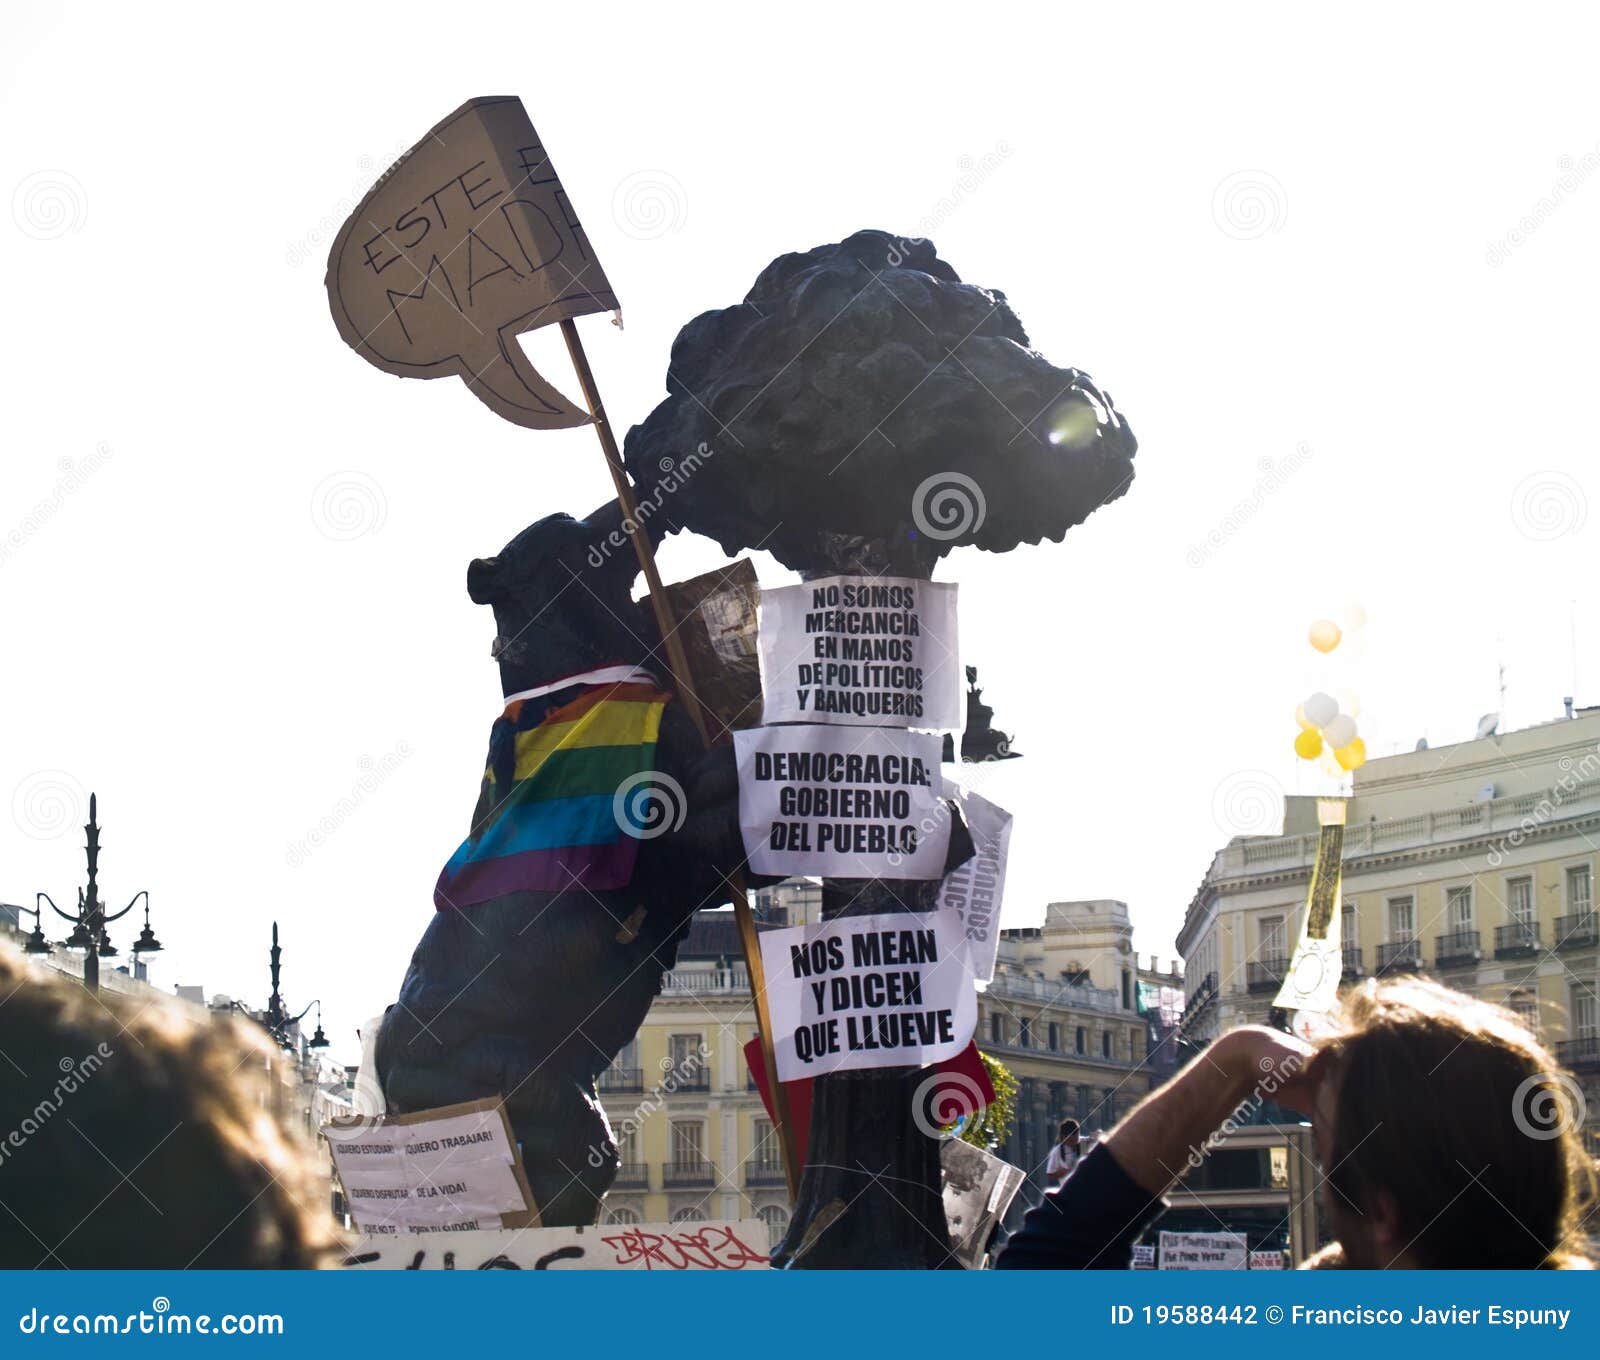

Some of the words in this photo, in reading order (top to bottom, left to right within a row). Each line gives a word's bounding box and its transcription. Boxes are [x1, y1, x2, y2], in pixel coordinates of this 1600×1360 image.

[363, 161, 503, 274] ESTE
[517, 144, 560, 185] E
[813, 586, 837, 609] NO
[843, 584, 914, 610] SOMOS
[805, 609, 920, 637] MERCANCÍA
[814, 636, 837, 659] EN
[842, 638, 912, 662] MANOS
[798, 662, 822, 686] DE
[826, 661, 923, 691] POLÍTICOS
[797, 689, 809, 711] Y
[814, 688, 923, 718] BANQUEROS
[755, 752, 931, 787] DEMOCRACIA:
[780, 787, 909, 819] GOBIERNO
[770, 822, 811, 851] DEL
[817, 823, 917, 855] PUEBLO
[790, 936, 844, 978] NOS
[852, 929, 938, 967] MEAN
[811, 980, 826, 1015] Y
[831, 971, 923, 1011] DICEN
[794, 1019, 840, 1063] QUE
[849, 1009, 955, 1051] LLUEVE
[440, 1131, 494, 1149] TRABAJAR!
[428, 1186, 438, 1197] LA
[439, 1182, 467, 1195] VIDA!
